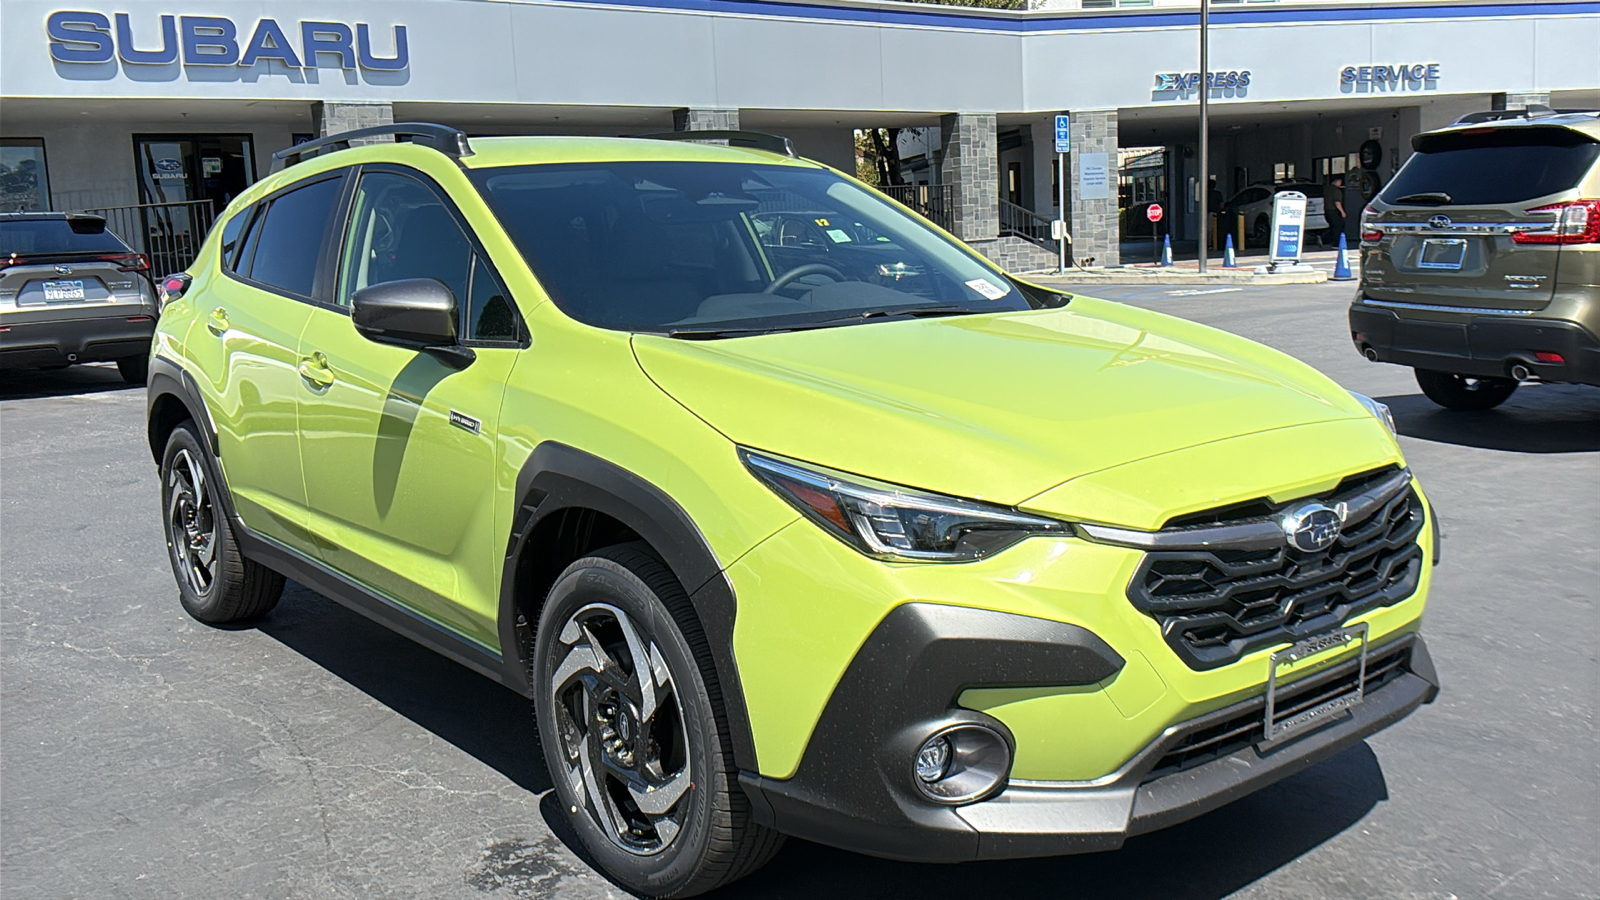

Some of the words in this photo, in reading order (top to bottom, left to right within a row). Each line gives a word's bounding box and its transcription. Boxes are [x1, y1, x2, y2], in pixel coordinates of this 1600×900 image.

[47, 10, 410, 72] SUBARU
[1157, 71, 1252, 90] EXPRESS
[1341, 64, 1440, 83] SERVICE
[1148, 209, 1162, 217] STOP
